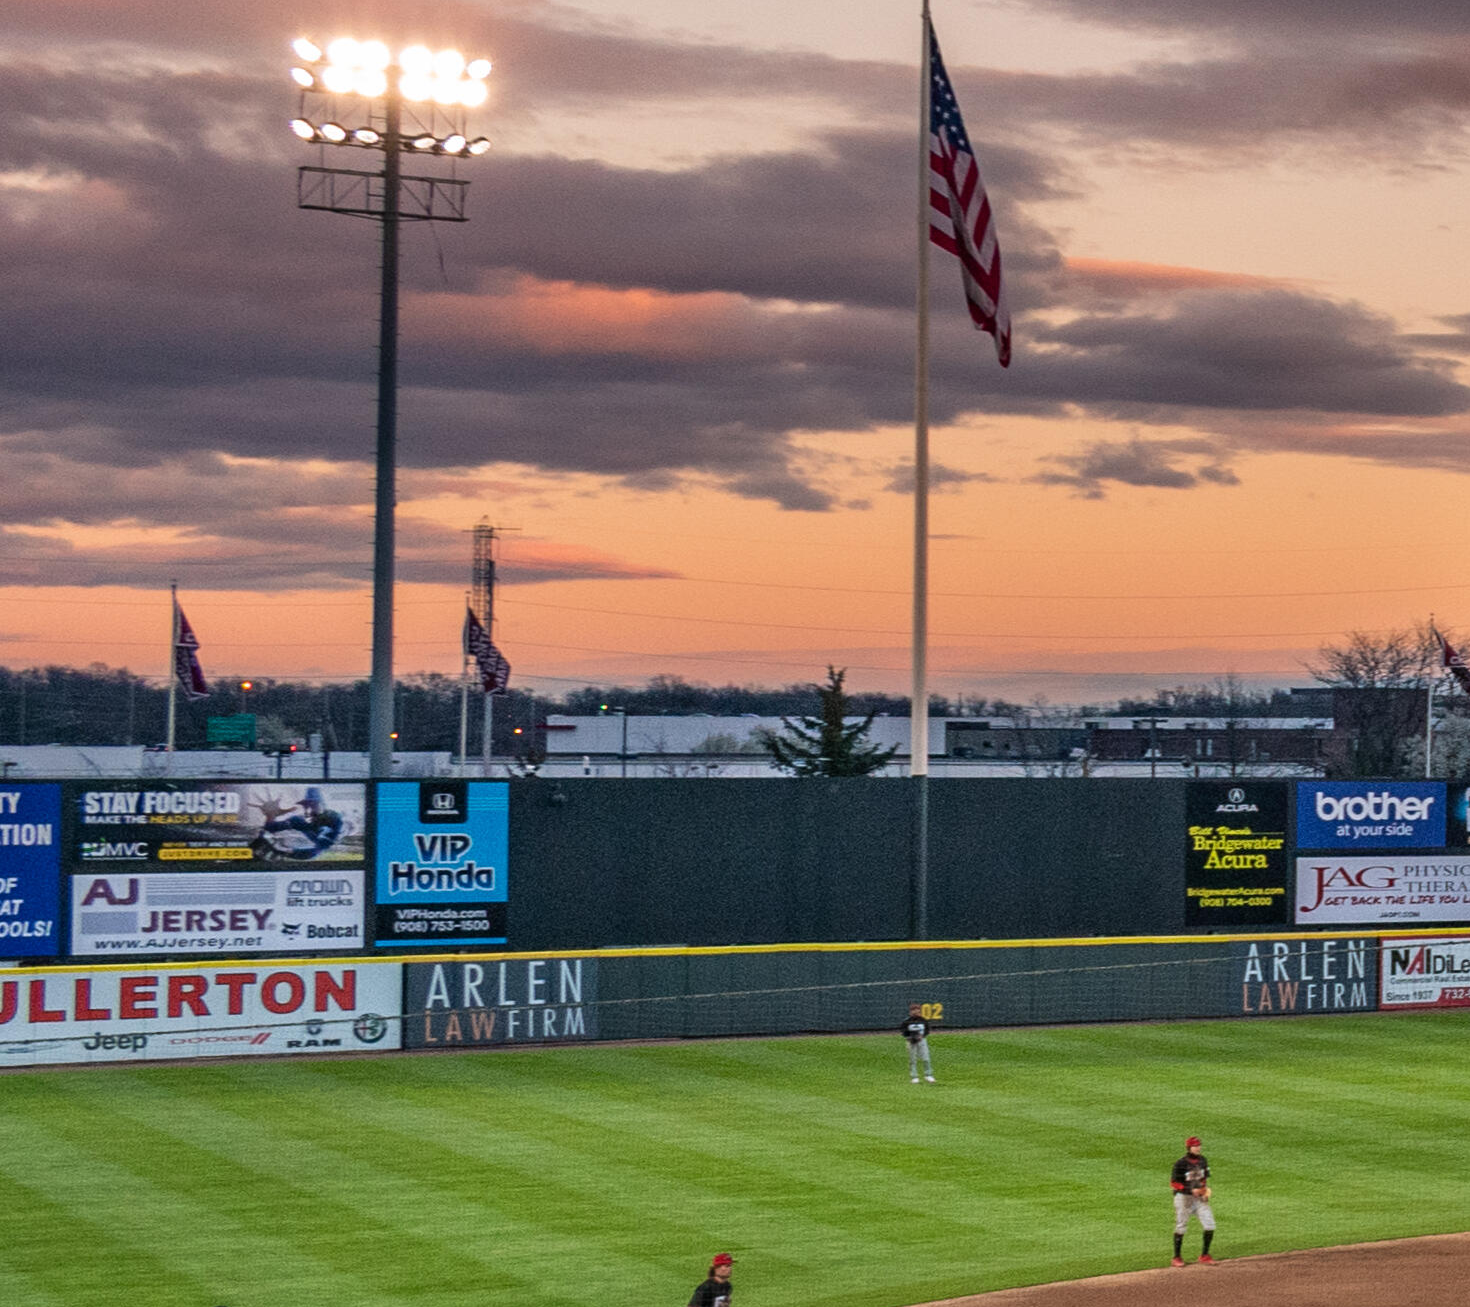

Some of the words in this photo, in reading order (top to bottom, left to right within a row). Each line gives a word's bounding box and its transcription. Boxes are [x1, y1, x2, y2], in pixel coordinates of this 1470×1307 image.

[85, 793, 142, 814] STAY
[145, 792, 241, 814] FOCUSED
[1315, 792, 1434, 821] brother
[1336, 825, 1350, 836] at
[1353, 825, 1384, 839] your
[1385, 824, 1413, 836] side
[413, 833, 472, 864] VIP
[1193, 836, 1284, 853] Bridgewater
[1204, 850, 1268, 869] Acura
[389, 861, 494, 897] Honda
[1300, 865, 1400, 913] JAG
[82, 878, 139, 906] AJ
[142, 909, 273, 933] JERSEY
[397, 909, 487, 919] VIPHonda.com
[307, 924, 358, 939] Bobcat
[1244, 940, 1366, 983] ARLEN
[425, 960, 582, 1009] ARLEN
[84, 1033, 148, 1052] Jeep
[287, 1038, 342, 1049] RAM
